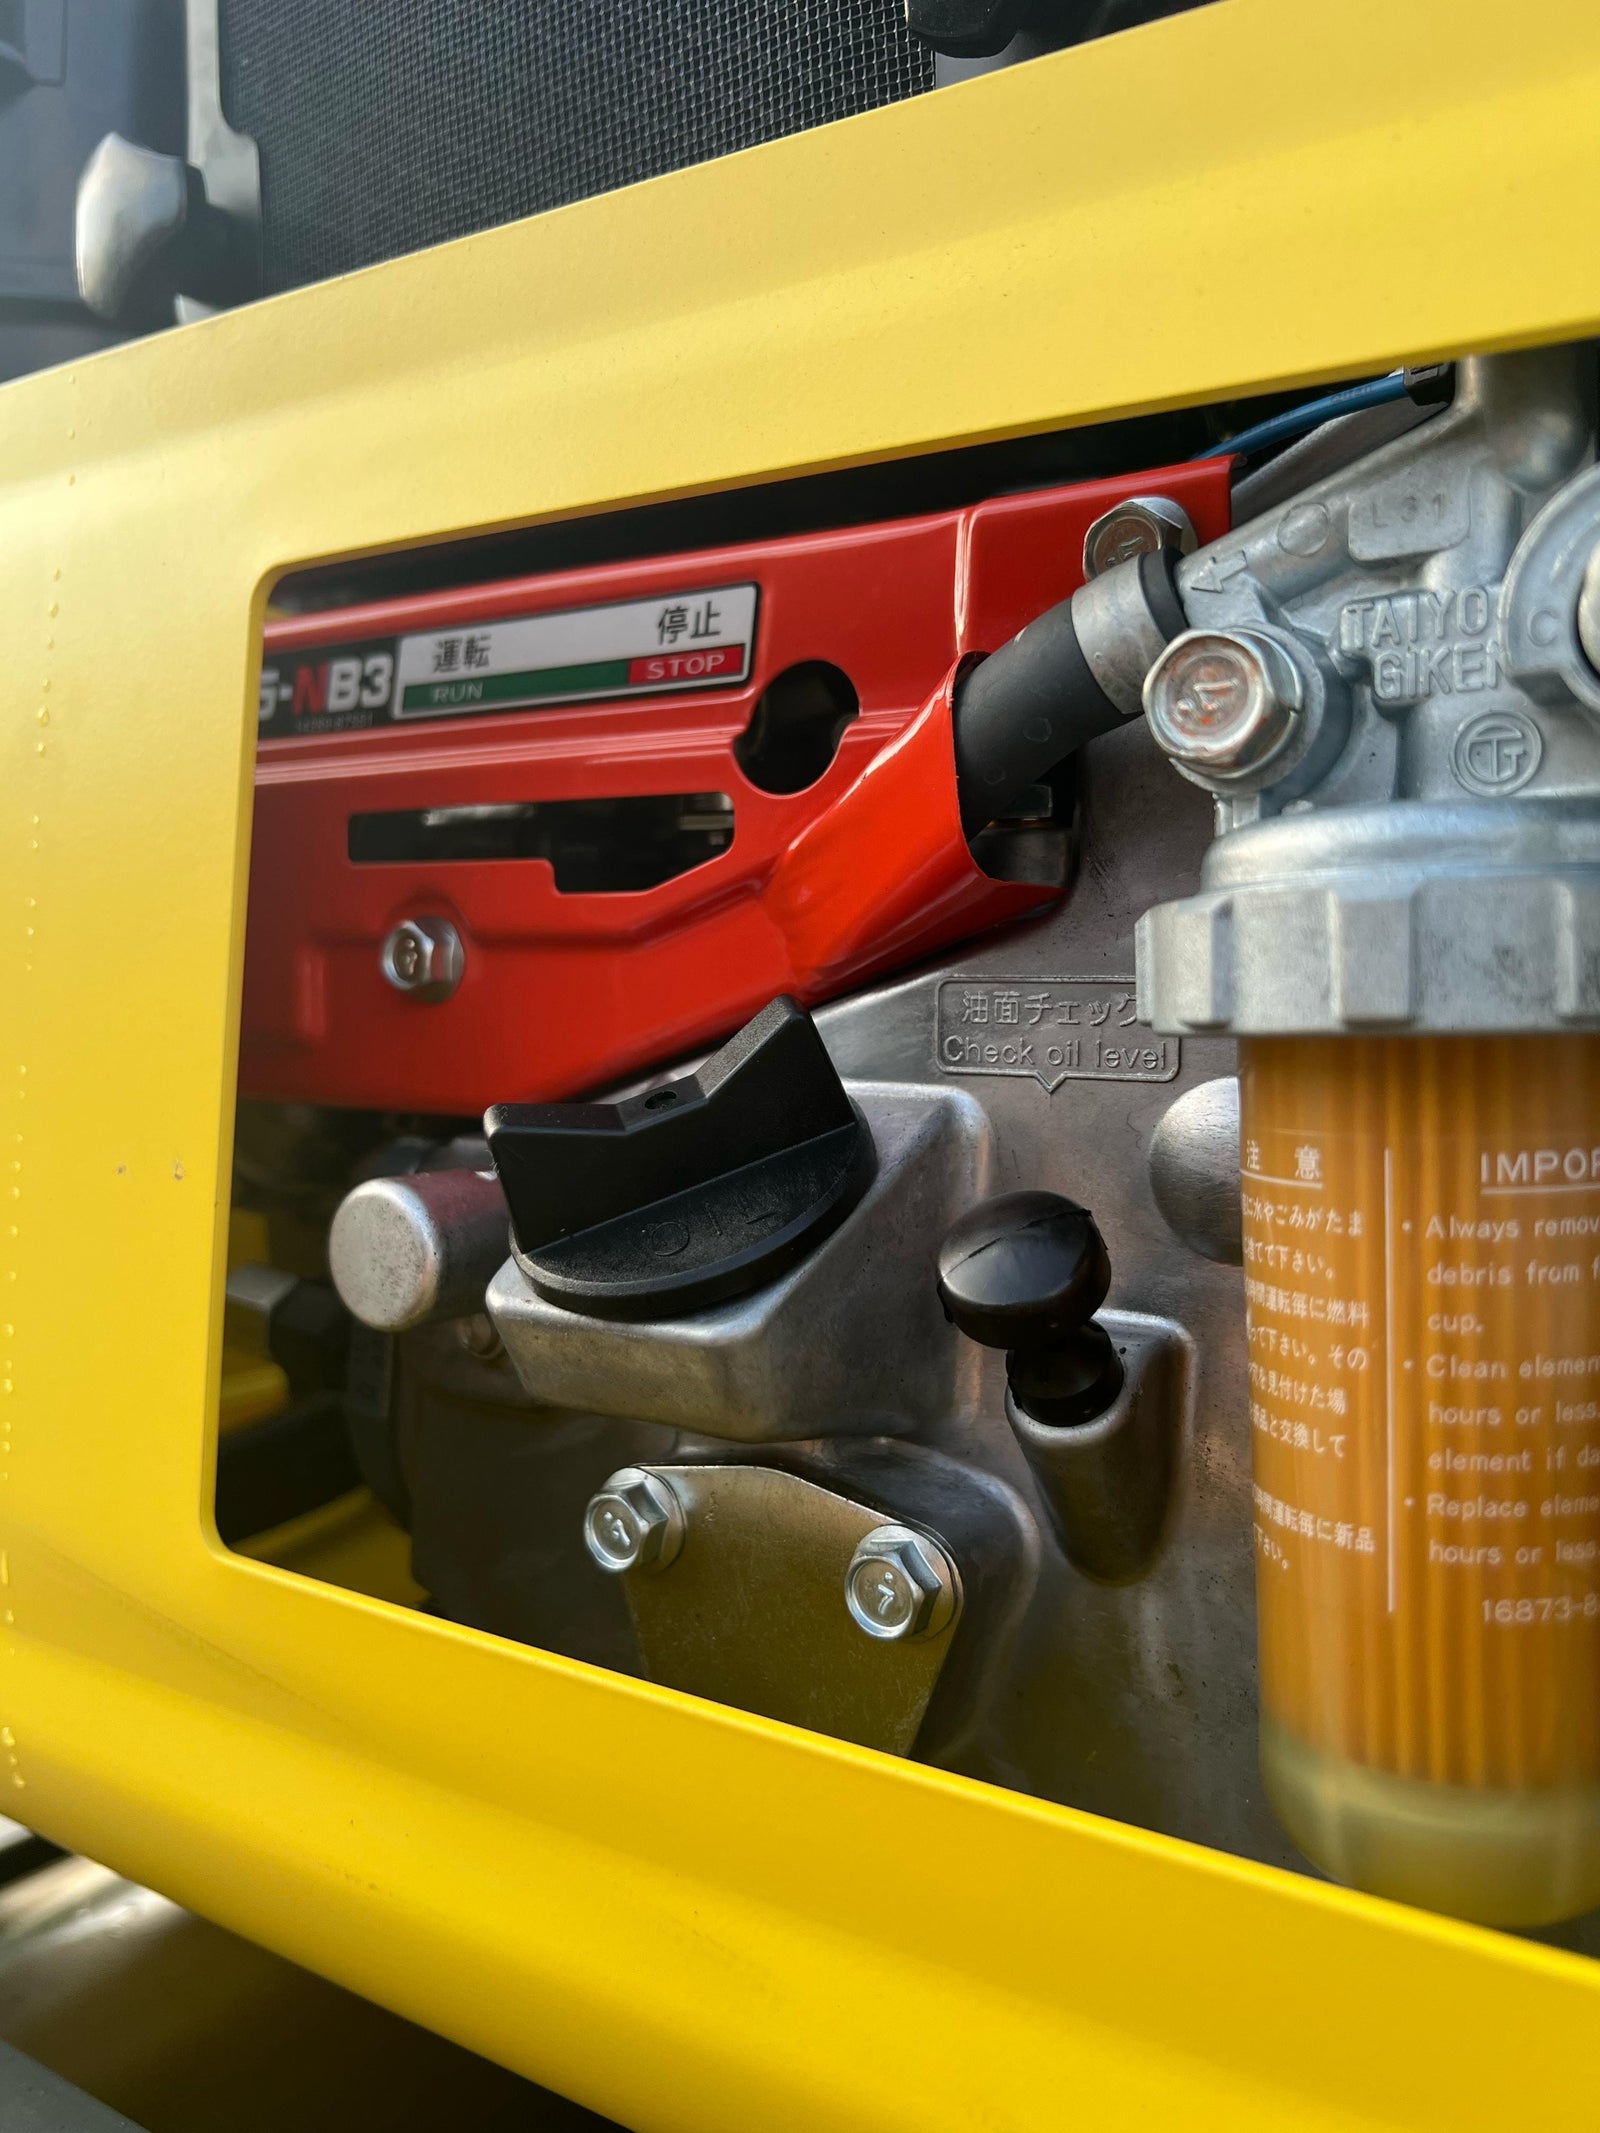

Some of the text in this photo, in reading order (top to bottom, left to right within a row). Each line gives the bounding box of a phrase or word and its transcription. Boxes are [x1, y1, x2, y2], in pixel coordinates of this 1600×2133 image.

[658, 601, 721, 646] 停止
[1340, 585, 1489, 650] TAIYO
[433, 633, 492, 673] 運転
[646, 653, 724, 680] STOP
[432, 682, 484, 702] RUN
[943, 1035, 1167, 1071] Check oil level
[1426, 1215, 1519, 1242] Always
[1427, 1263, 1512, 1287] debris
[1527, 1260, 1580, 1286] from
[1427, 1313, 1484, 1335] cup.
[1426, 1353, 1506, 1379] Clean
[1429, 1402, 1502, 1426] hours
[1515, 1407, 1541, 1425] or
[1428, 1450, 1532, 1473] element
[1546, 1447, 1566, 1470] if
[1426, 1493, 1528, 1521] Replace
[1429, 1540, 1503, 1566] hours
[1515, 1545, 1543, 1565] or
